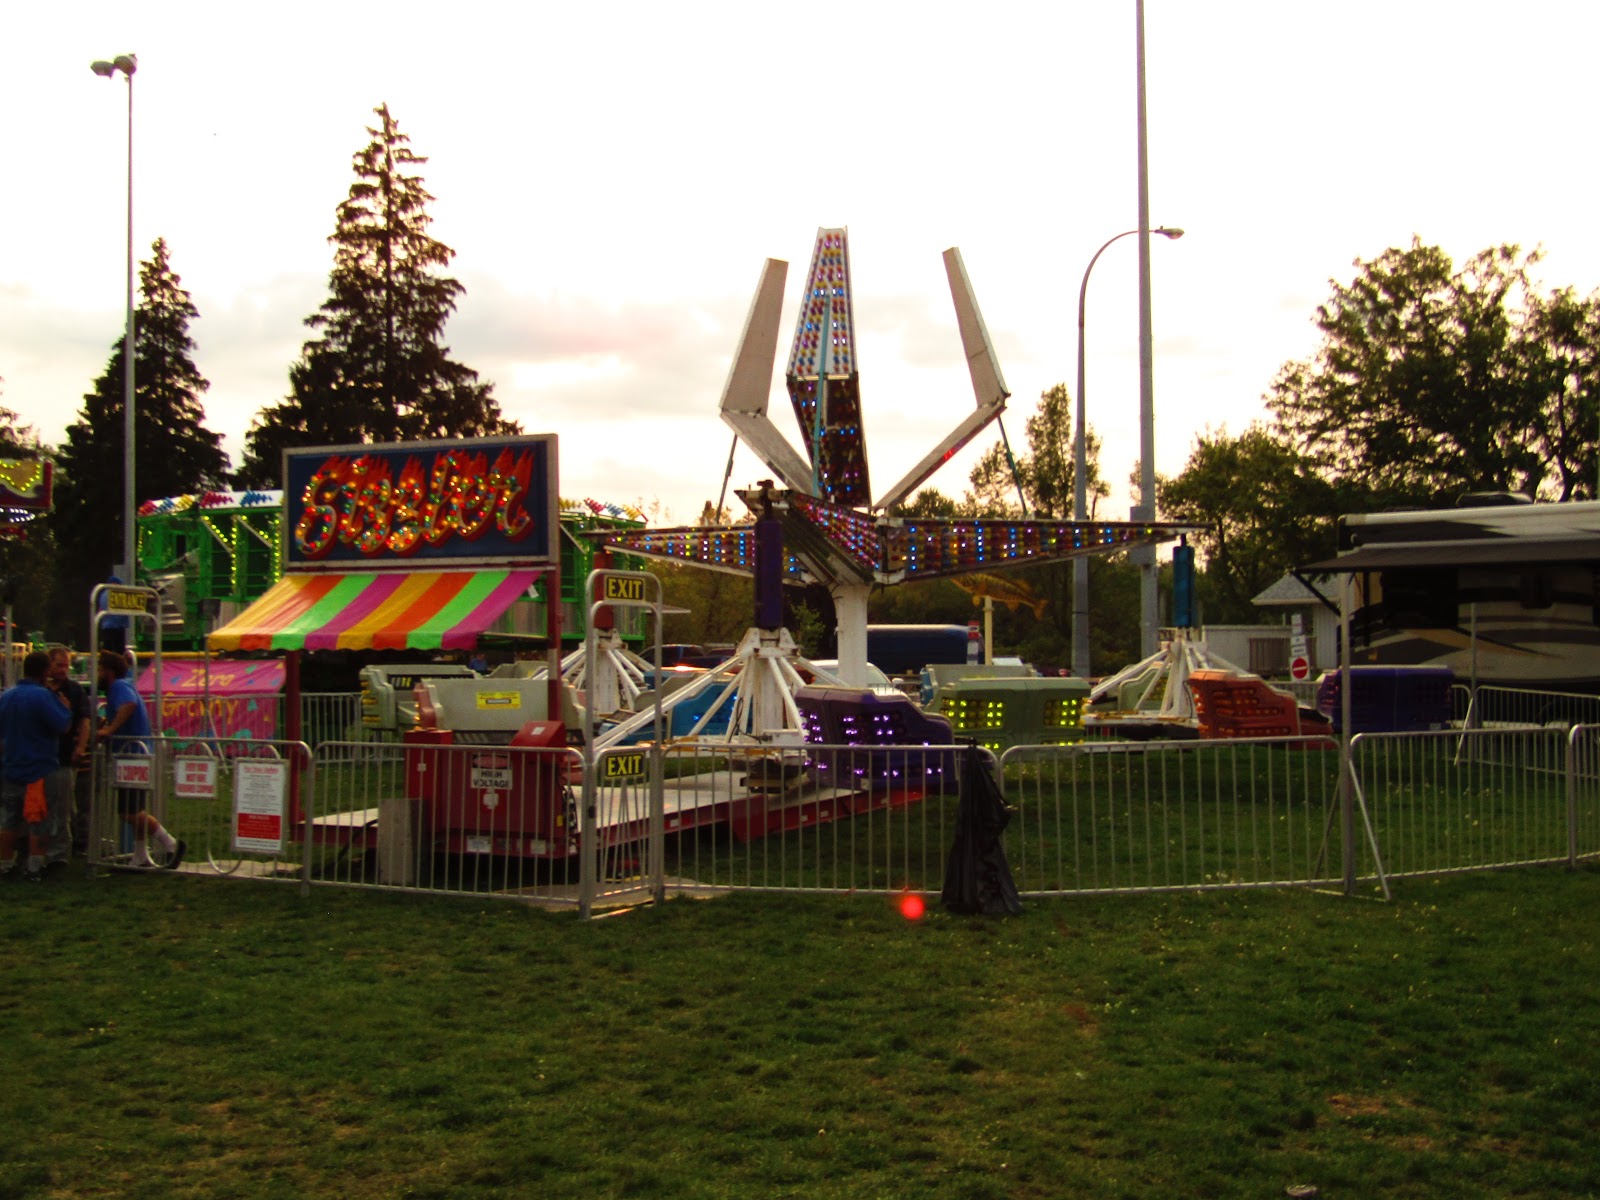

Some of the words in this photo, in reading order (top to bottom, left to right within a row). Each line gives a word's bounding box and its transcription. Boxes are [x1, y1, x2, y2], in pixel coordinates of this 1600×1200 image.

[608, 578, 642, 599] EXIT
[110, 591, 146, 610] ENTRANCE
[180, 668, 236, 687] Zero
[607, 755, 642, 776] EXIT
